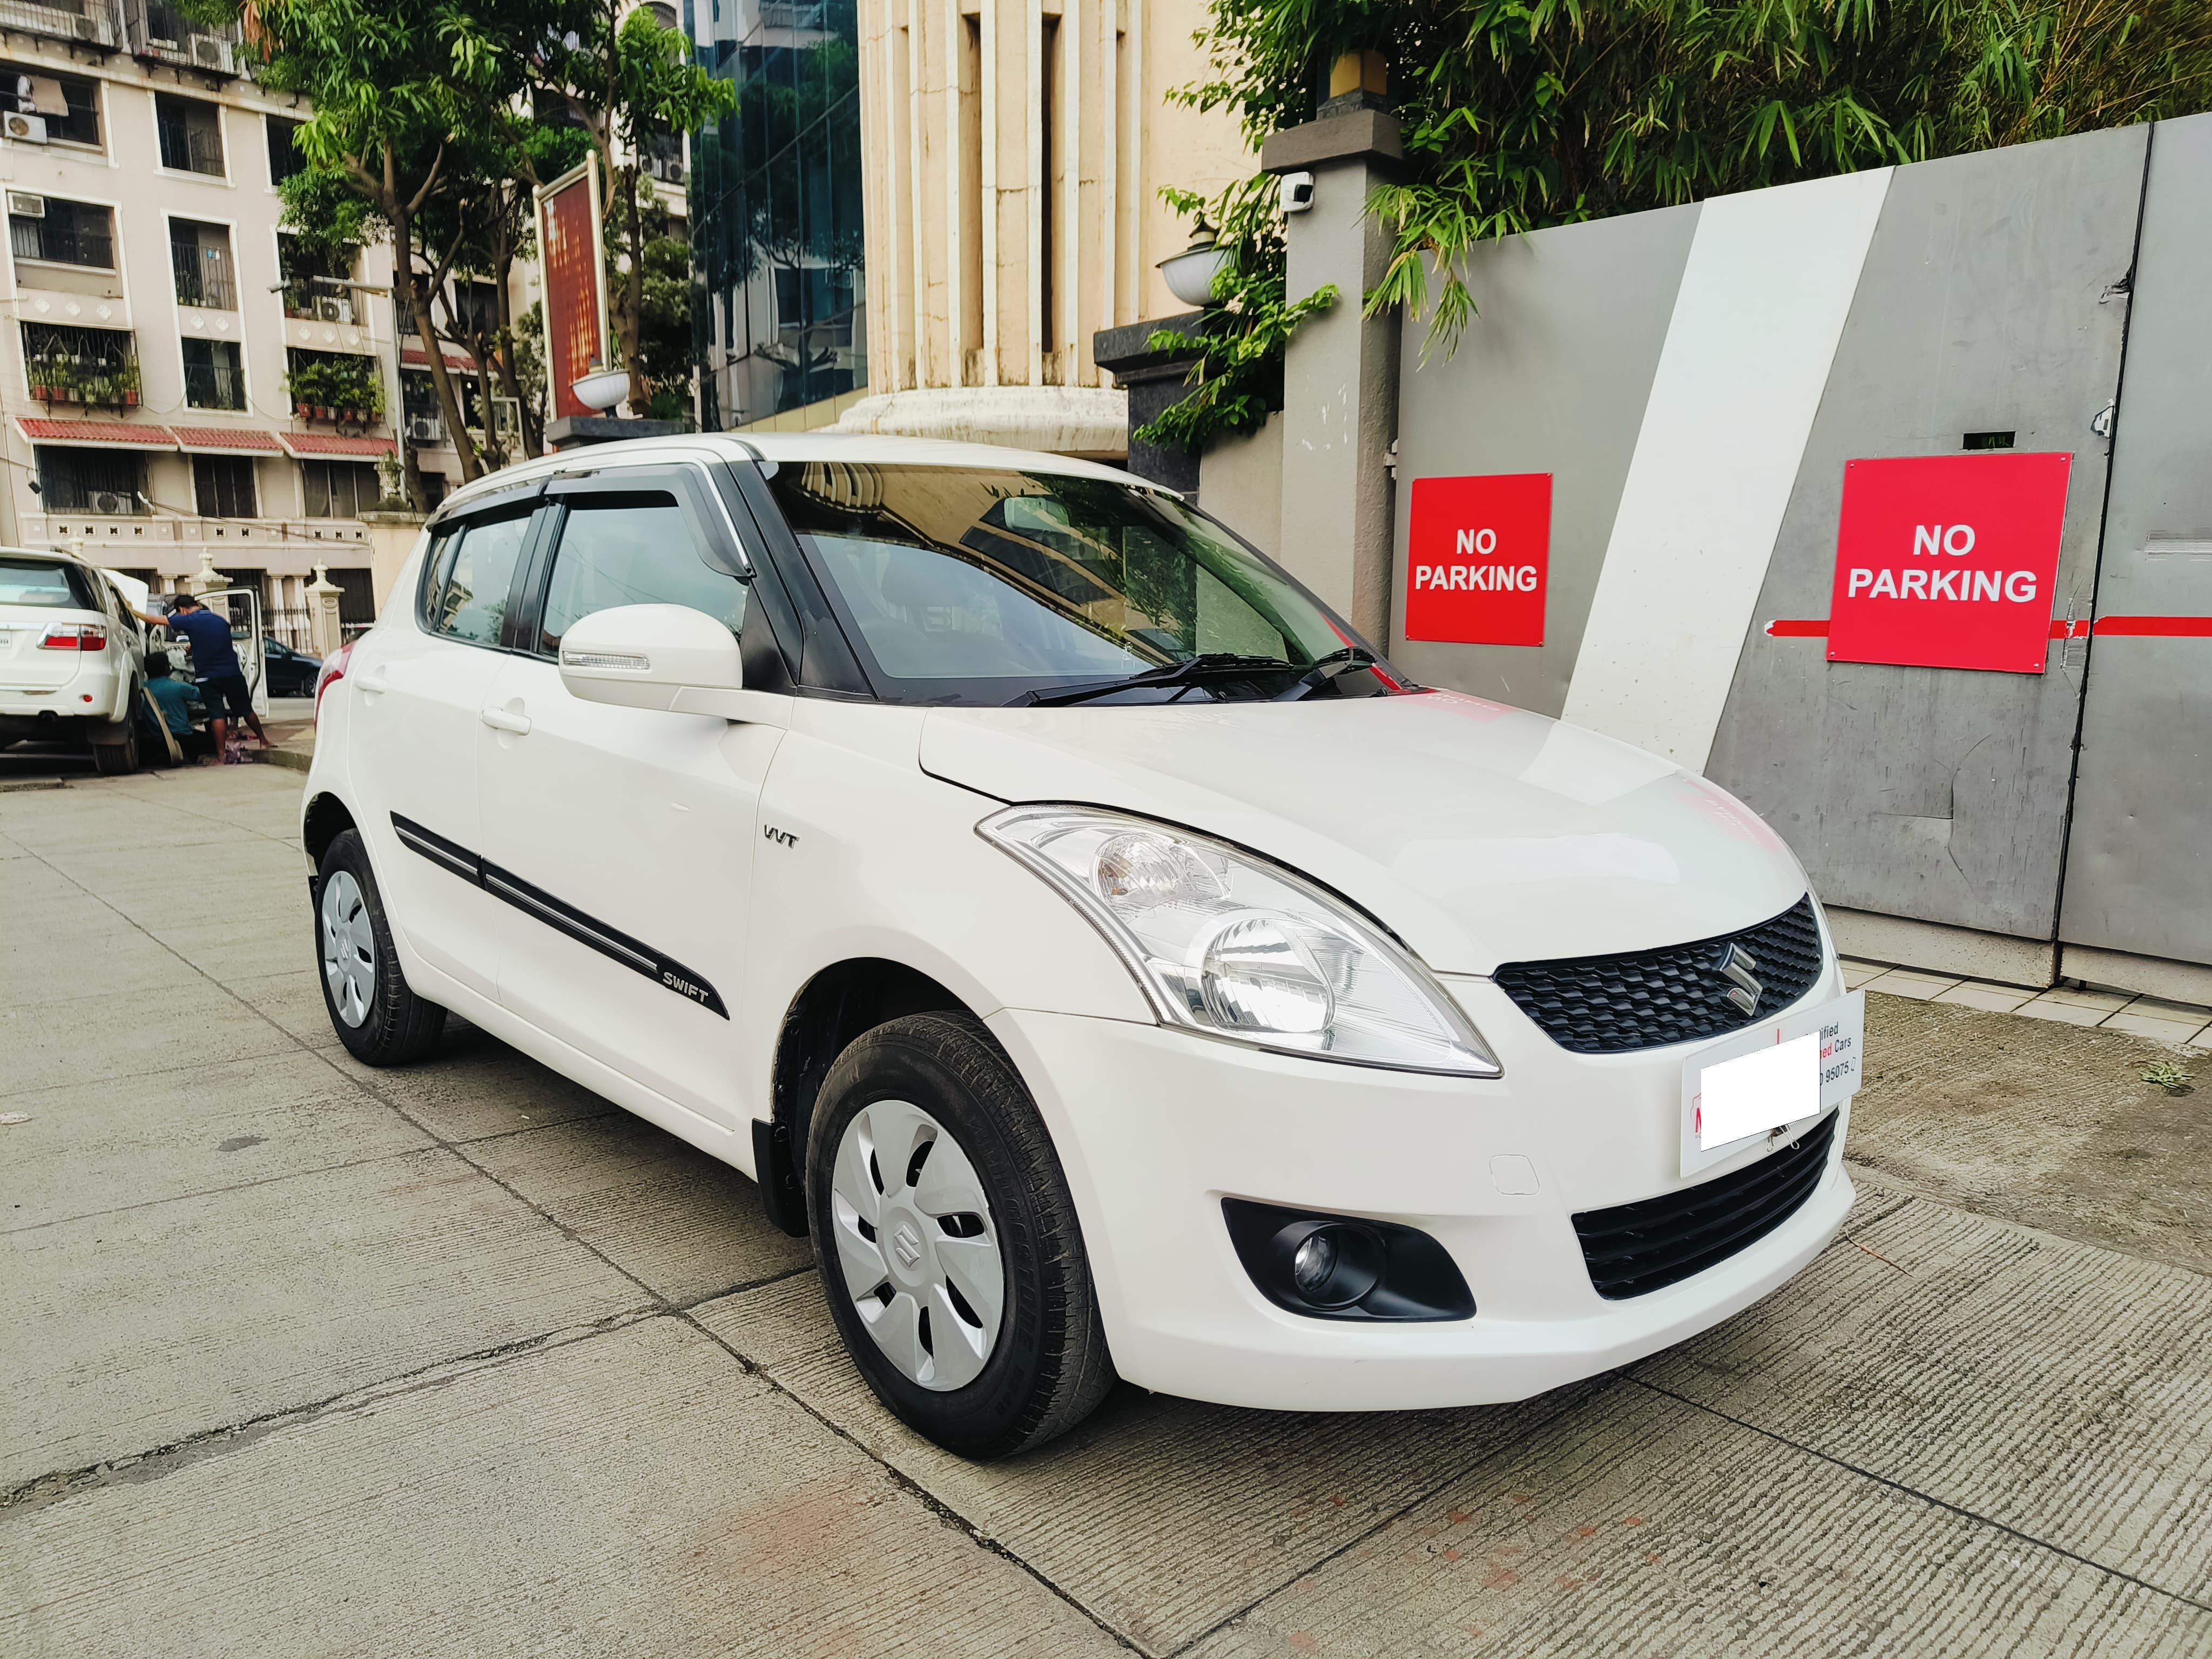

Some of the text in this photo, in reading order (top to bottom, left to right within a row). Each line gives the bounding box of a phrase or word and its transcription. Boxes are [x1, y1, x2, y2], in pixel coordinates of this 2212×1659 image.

[1456, 528, 1496, 555] NO
[1913, 524, 1975, 556] NO
[1415, 565, 1537, 592] PARKING
[1847, 568, 2037, 603] PARKING
[663, 972, 709, 1003] SWIFT
[1820, 1021, 1839, 1041] ified
[1835, 1037, 1851, 1053] Cars
[1826, 1061, 1849, 1083] 95075
